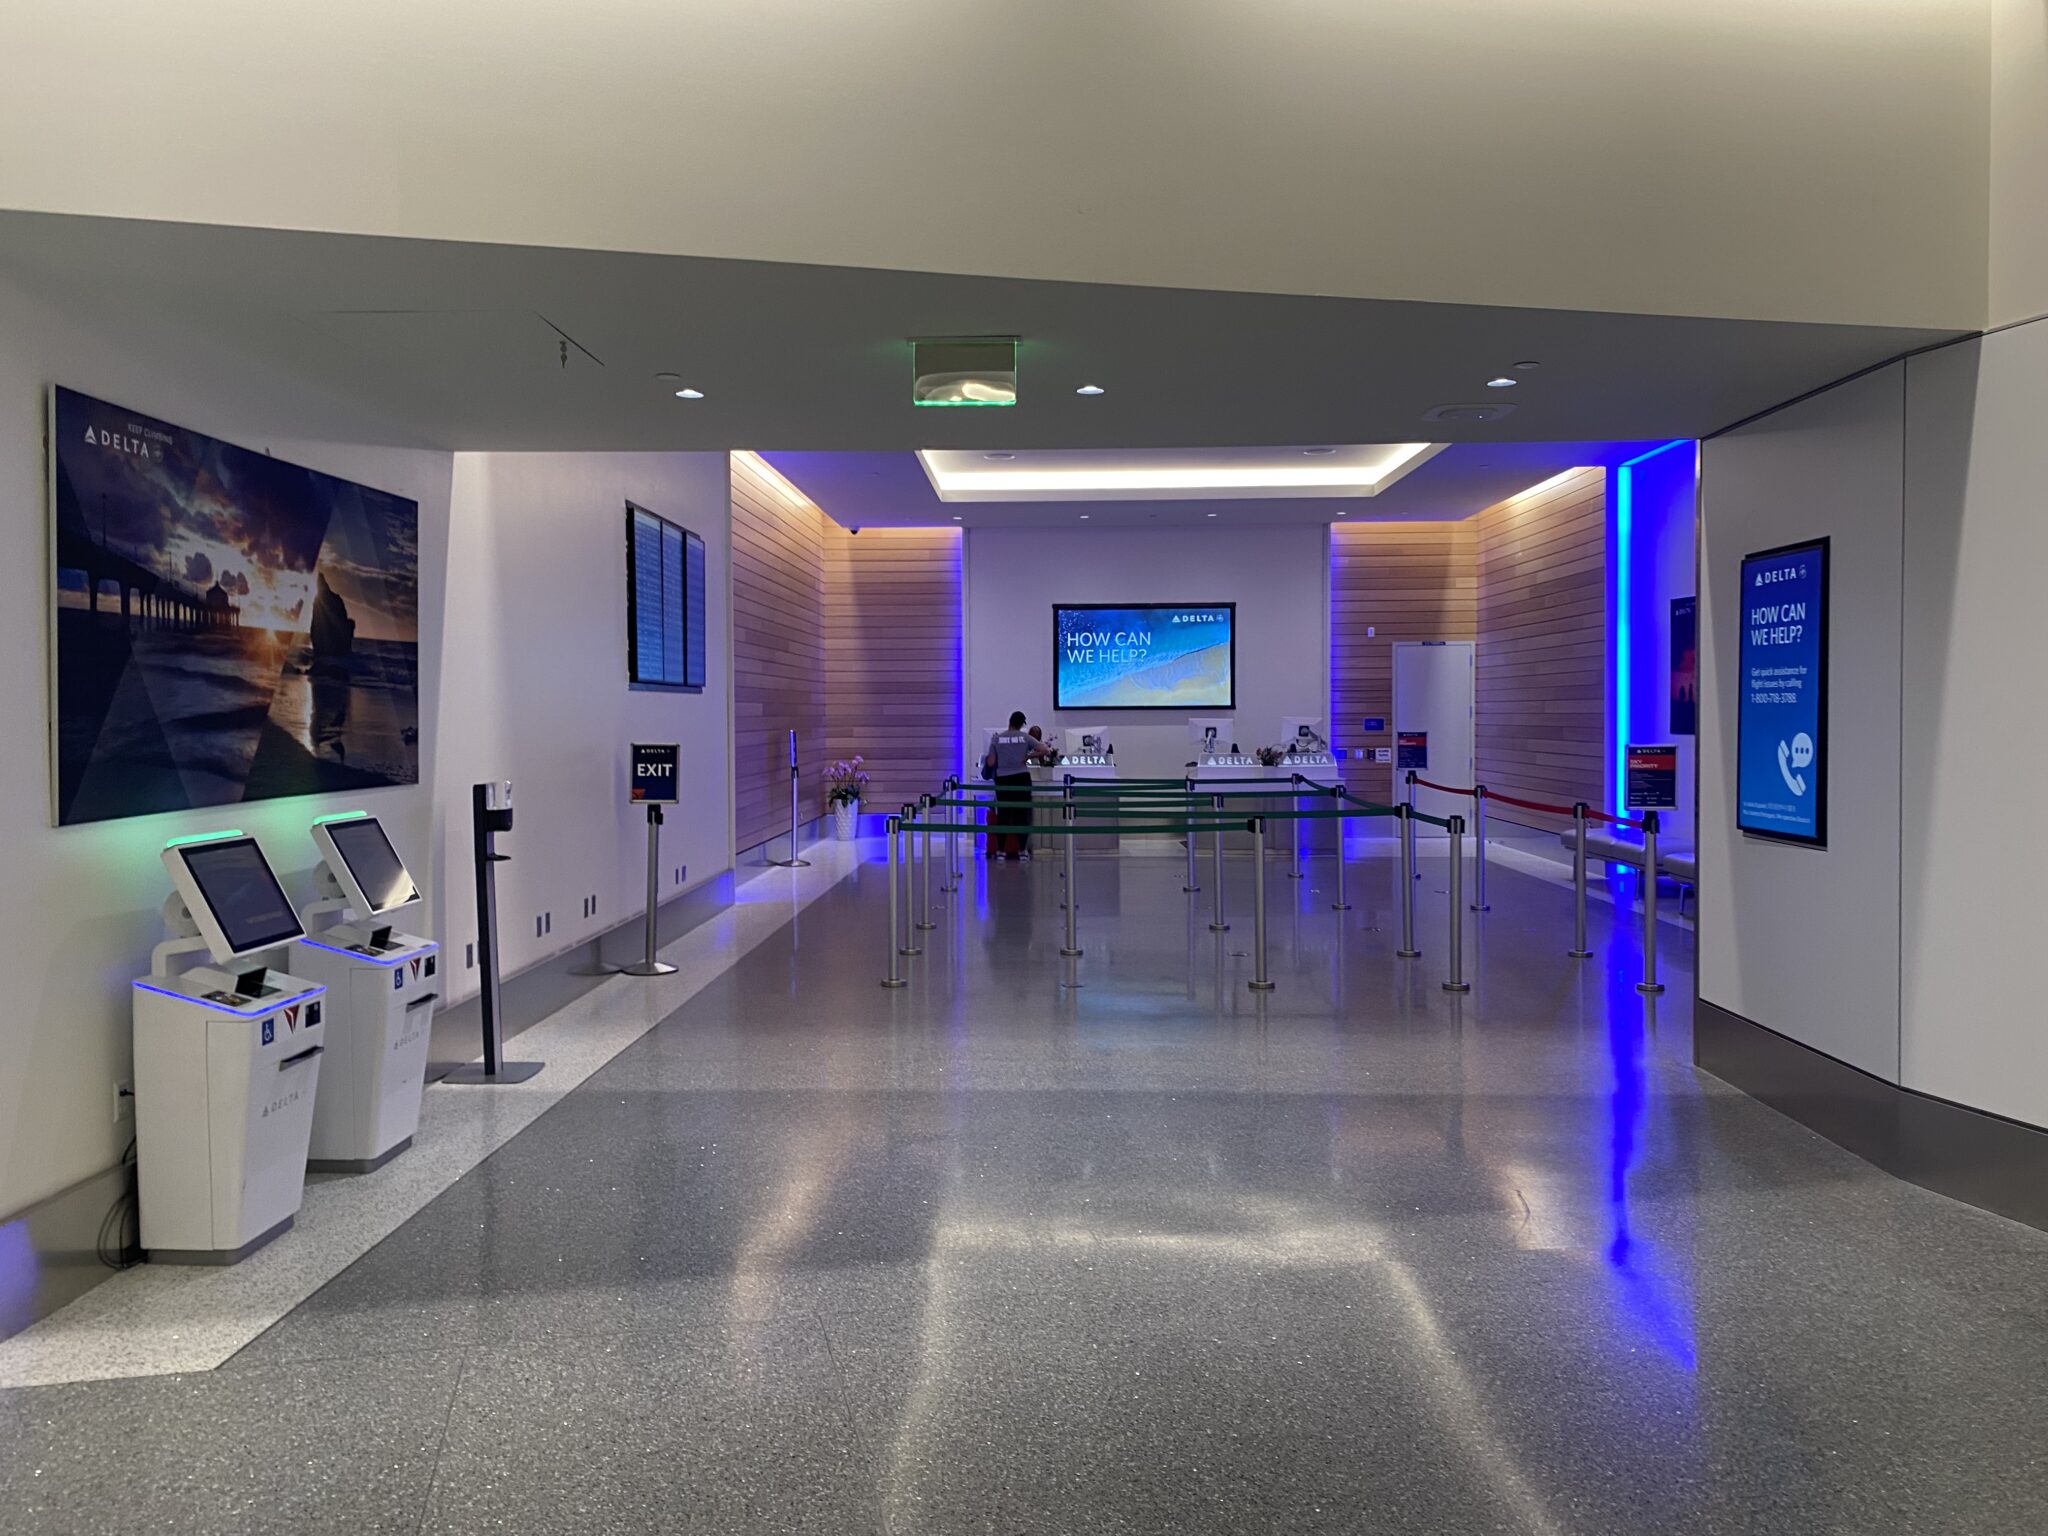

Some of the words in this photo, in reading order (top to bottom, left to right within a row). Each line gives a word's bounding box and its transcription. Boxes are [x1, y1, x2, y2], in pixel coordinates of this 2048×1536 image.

[101, 429, 149, 458] DELTA
[1764, 567, 1797, 584] DELTA
[1182, 614, 1214, 623] DELTA
[1751, 605, 1779, 625] HOW
[1781, 602, 1806, 622] CAN
[1067, 632, 1110, 647] HOW
[1114, 631, 1151, 647] CAN
[1751, 628, 1769, 646] WE
[1770, 625, 1803, 645] HELP?
[1067, 649, 1094, 663] WE
[1099, 649, 1147, 663] HELP?
[1072, 756, 1106, 765] DELTA
[1218, 756, 1253, 765] DELTA
[1294, 755, 1328, 764] DELTA
[637, 763, 673, 777] EXIT
[271, 1091, 299, 1113] DELTA
